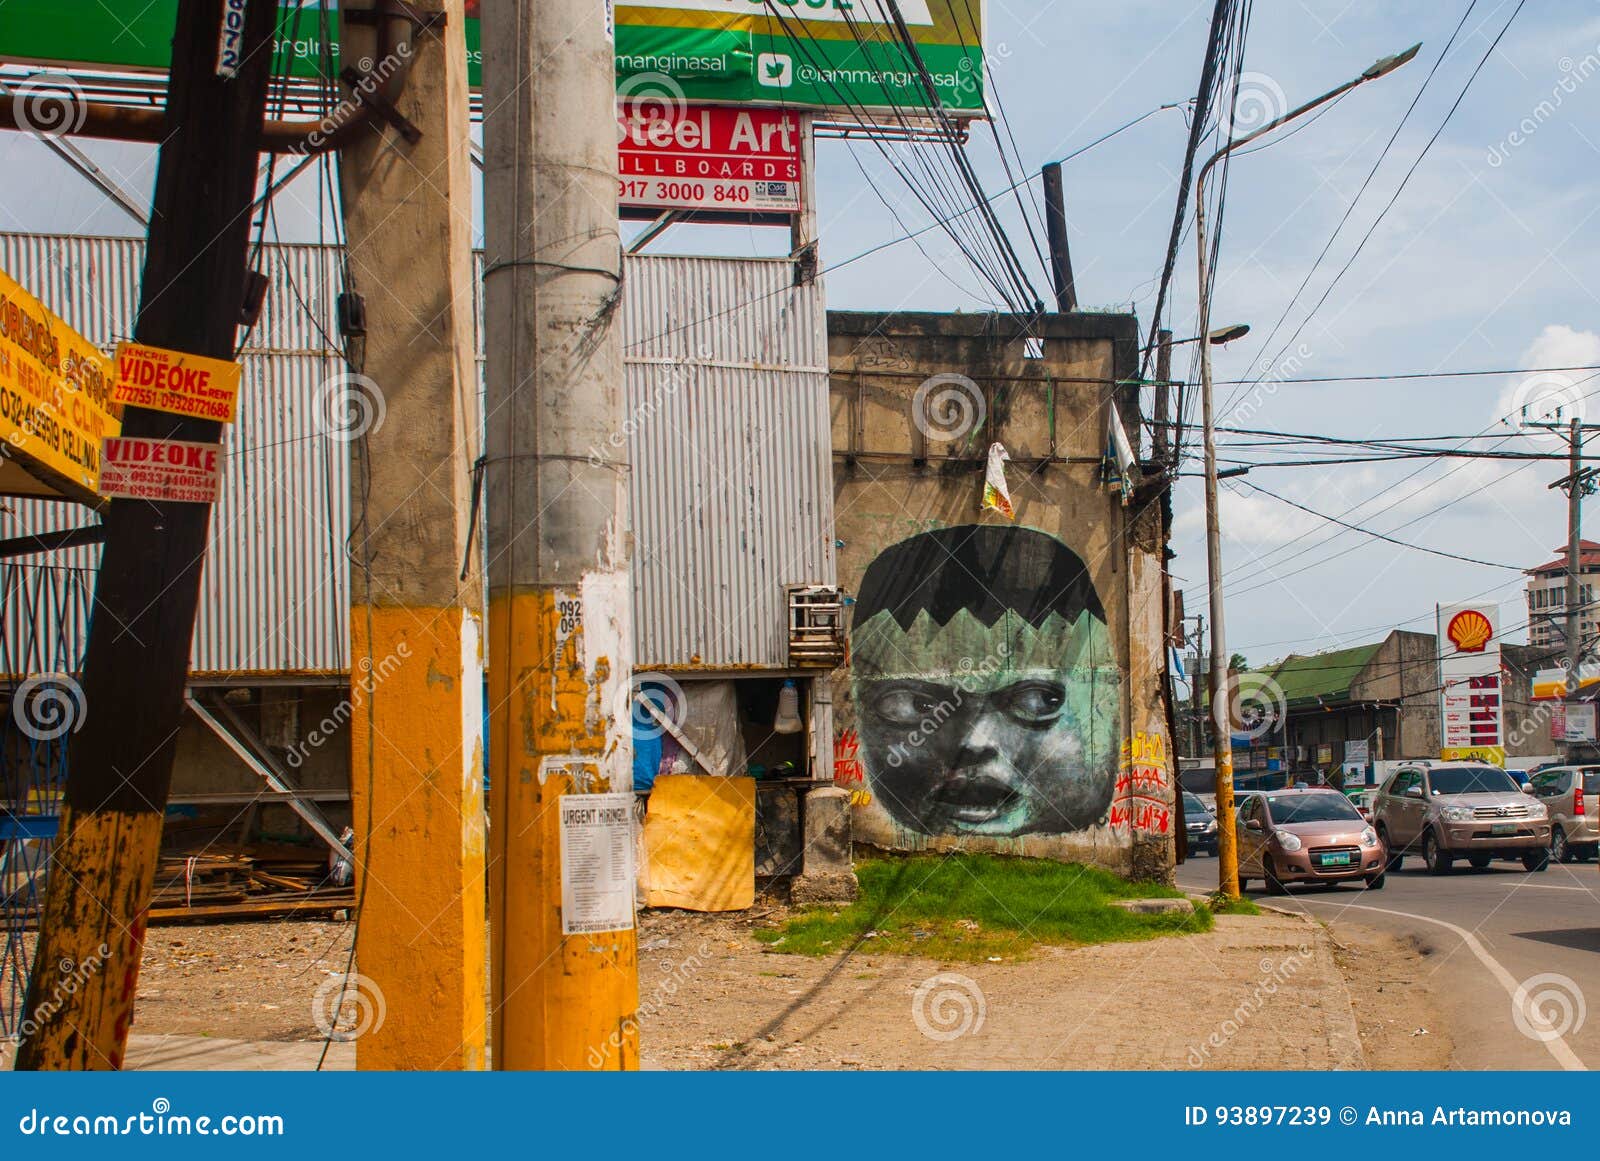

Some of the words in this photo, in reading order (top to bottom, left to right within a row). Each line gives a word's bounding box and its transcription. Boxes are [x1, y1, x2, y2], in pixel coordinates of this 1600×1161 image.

[729, 112, 797, 153] Art
[656, 182, 705, 201] 3000
[713, 184, 750, 203] 840
[120, 357, 211, 397] VIDEOKE
[207, 388, 234, 401] RENT
[106, 439, 217, 473] VIDEOKE
[563, 808, 596, 825] URGENT
